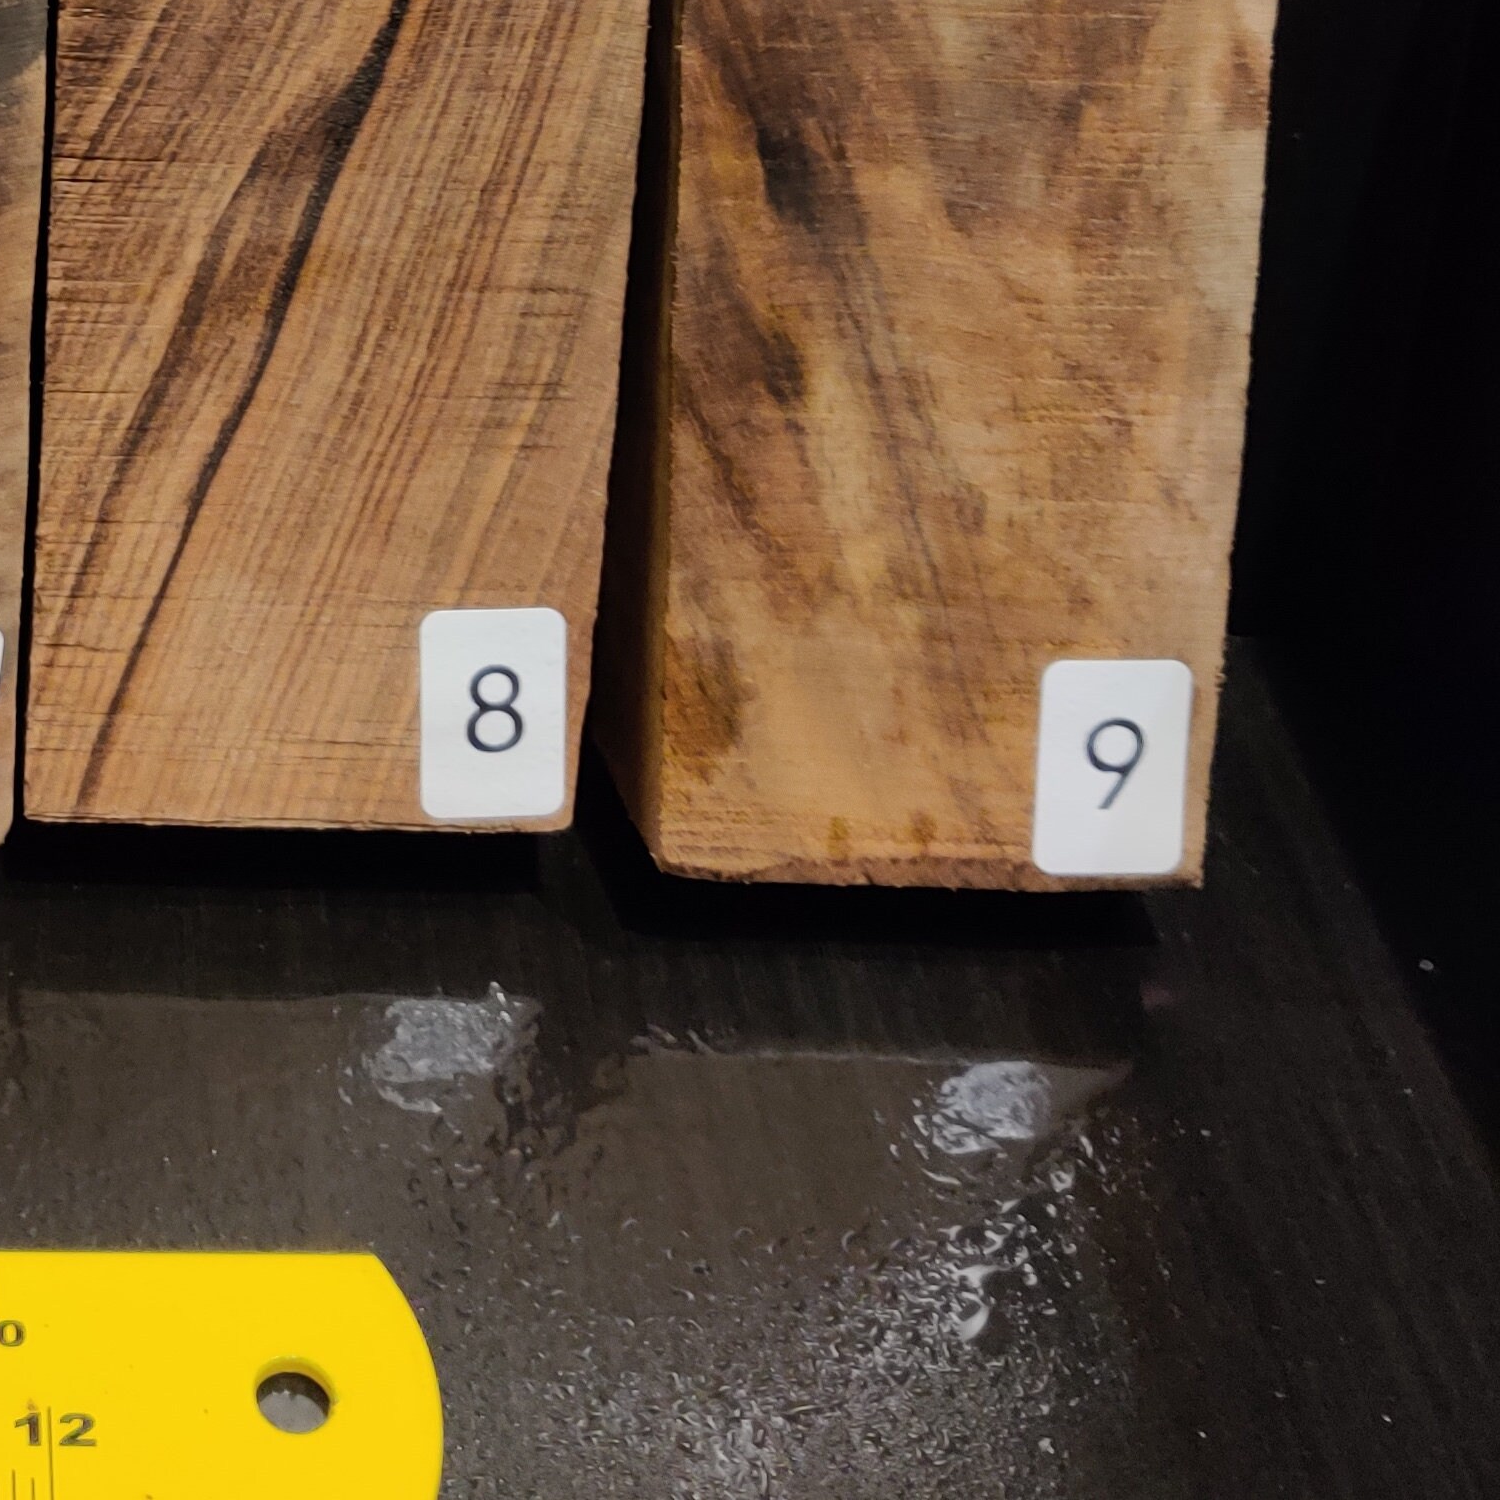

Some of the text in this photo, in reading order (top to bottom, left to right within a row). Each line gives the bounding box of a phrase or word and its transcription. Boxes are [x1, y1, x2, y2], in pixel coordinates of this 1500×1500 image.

[465, 665, 524, 754] 8
[1085, 717, 1145, 810] 9
[14, 1413, 96, 1447] 12
